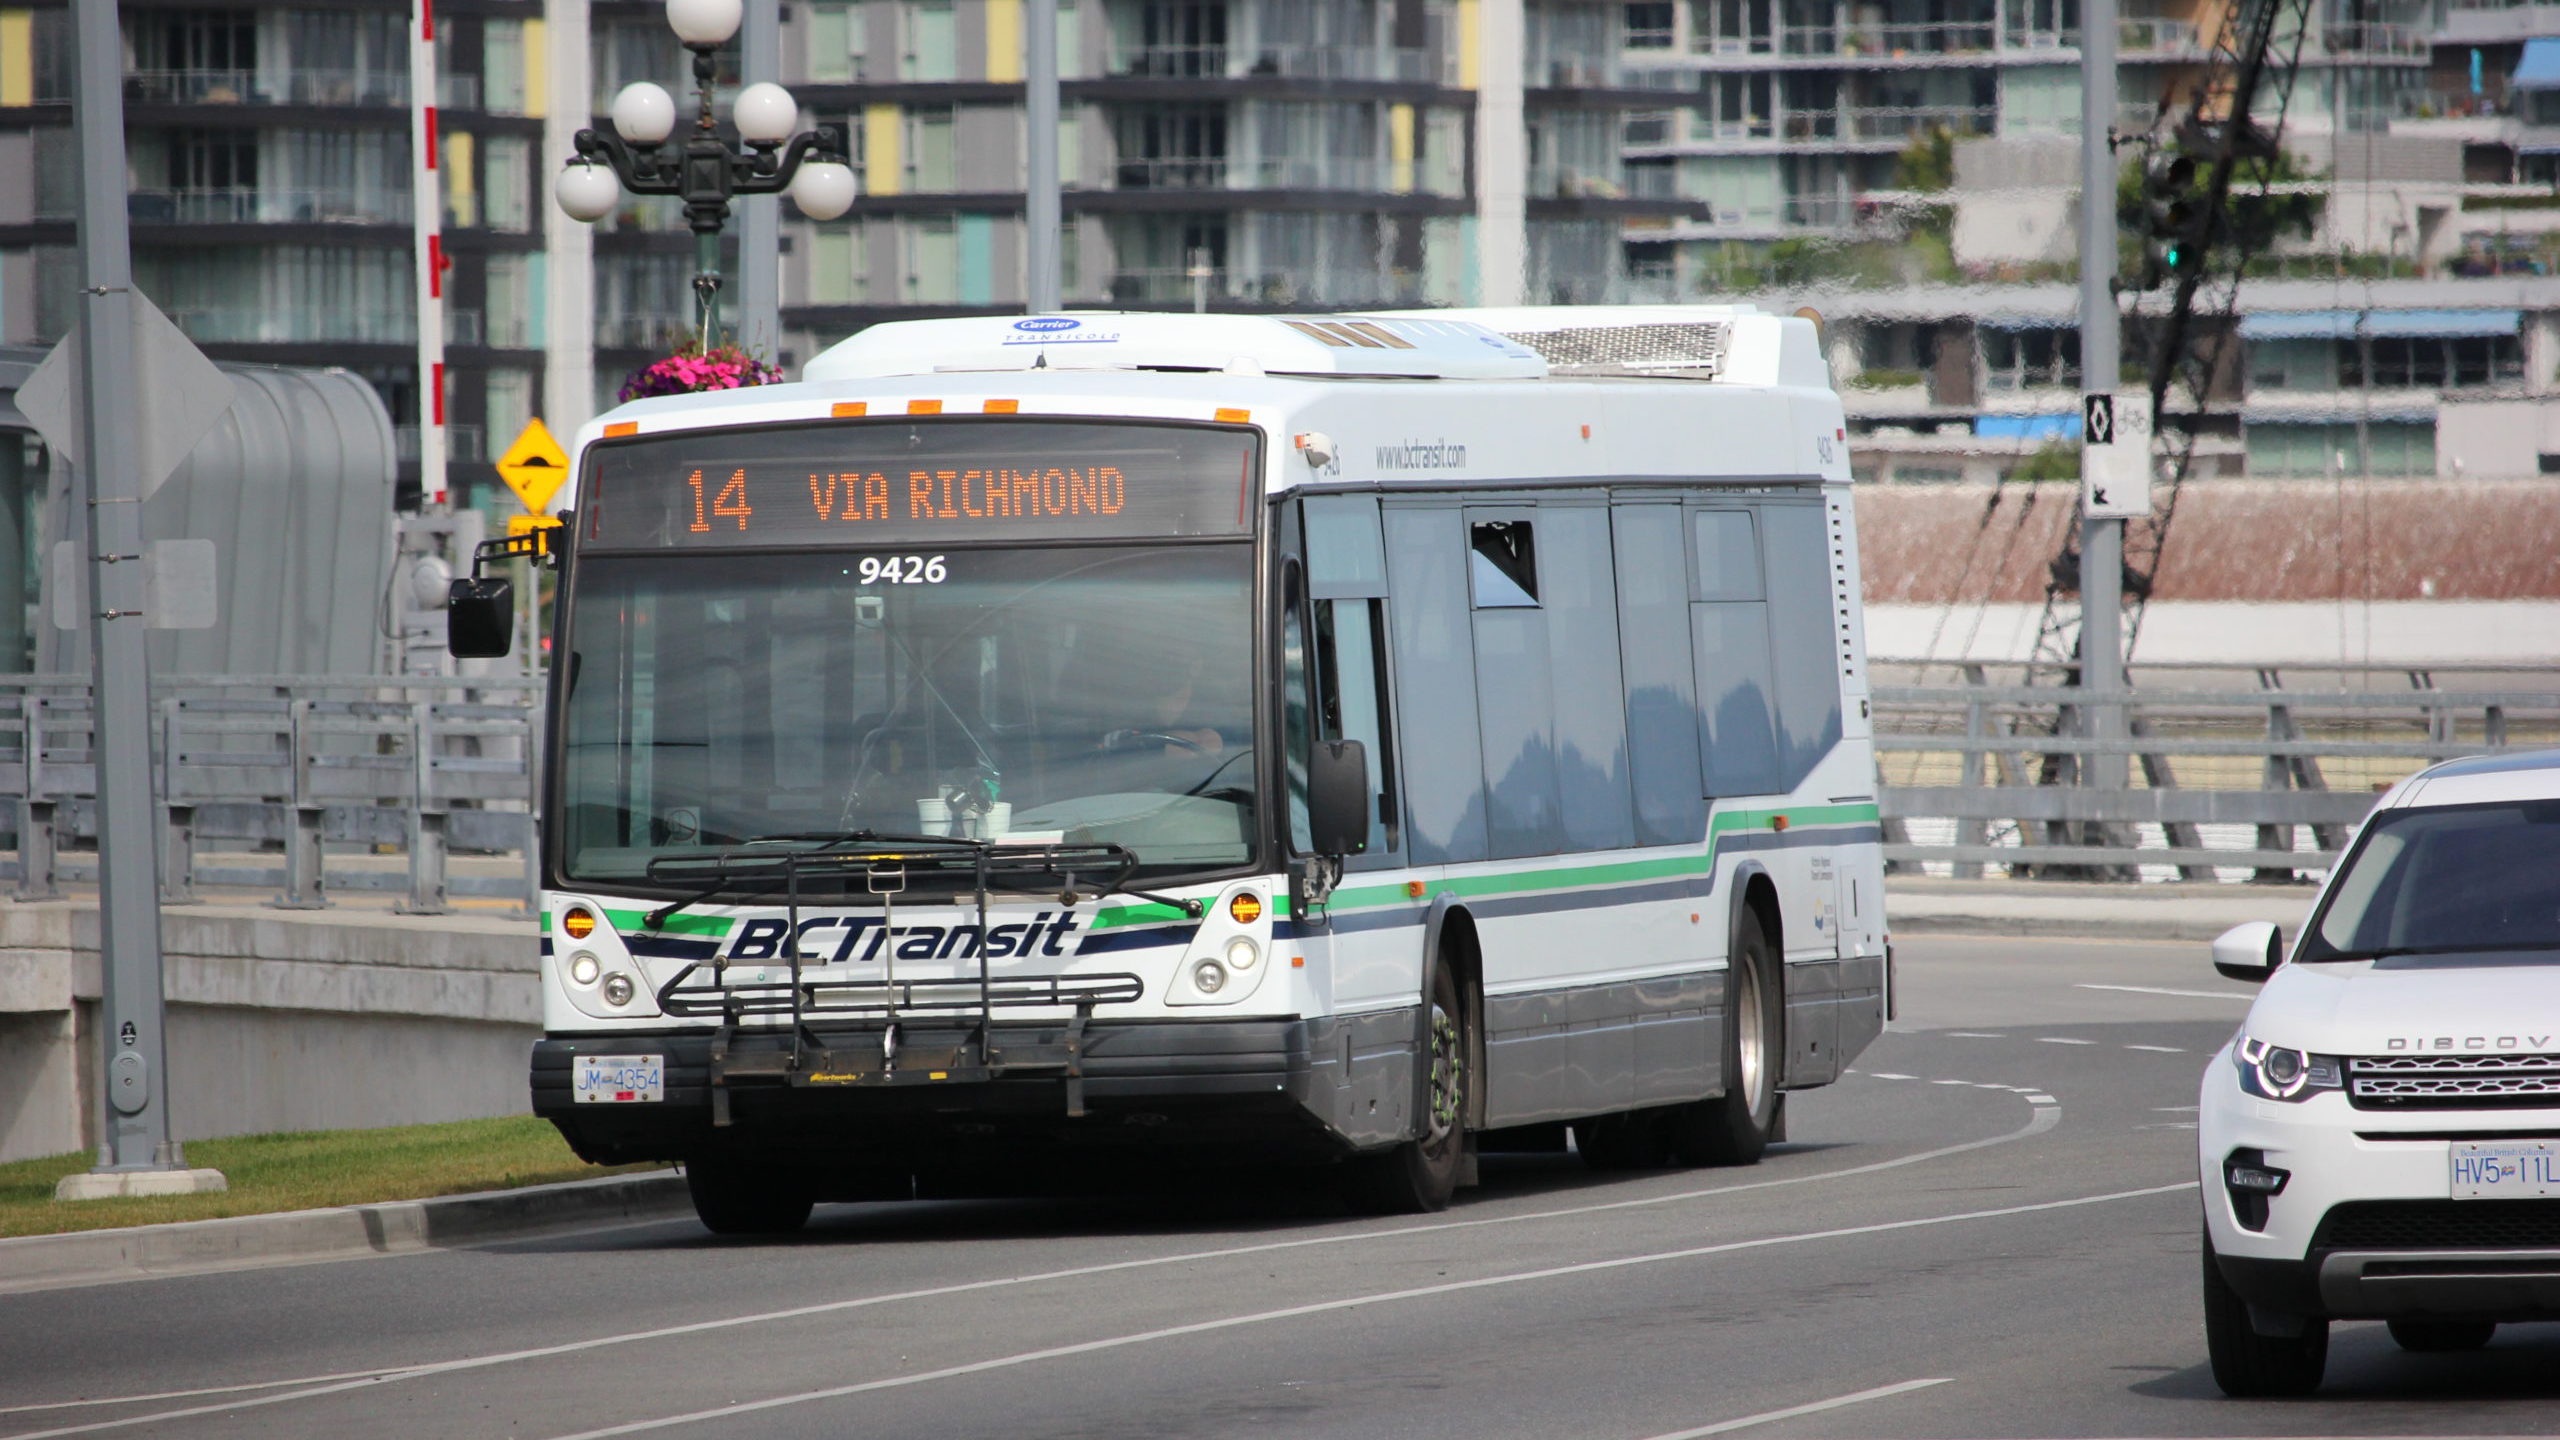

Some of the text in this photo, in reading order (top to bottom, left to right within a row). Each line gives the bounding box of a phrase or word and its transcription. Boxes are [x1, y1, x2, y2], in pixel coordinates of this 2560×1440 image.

[1004, 332, 1122, 342] TRANSICOLD
[1020, 320, 1074, 330] Carrier
[1376, 438, 1466, 470] www.bctransit.com
[688, 466, 1125, 532] 14 VIA RICHMOND
[858, 555, 947, 585] 9426
[614, 1068, 659, 1090] 4354
